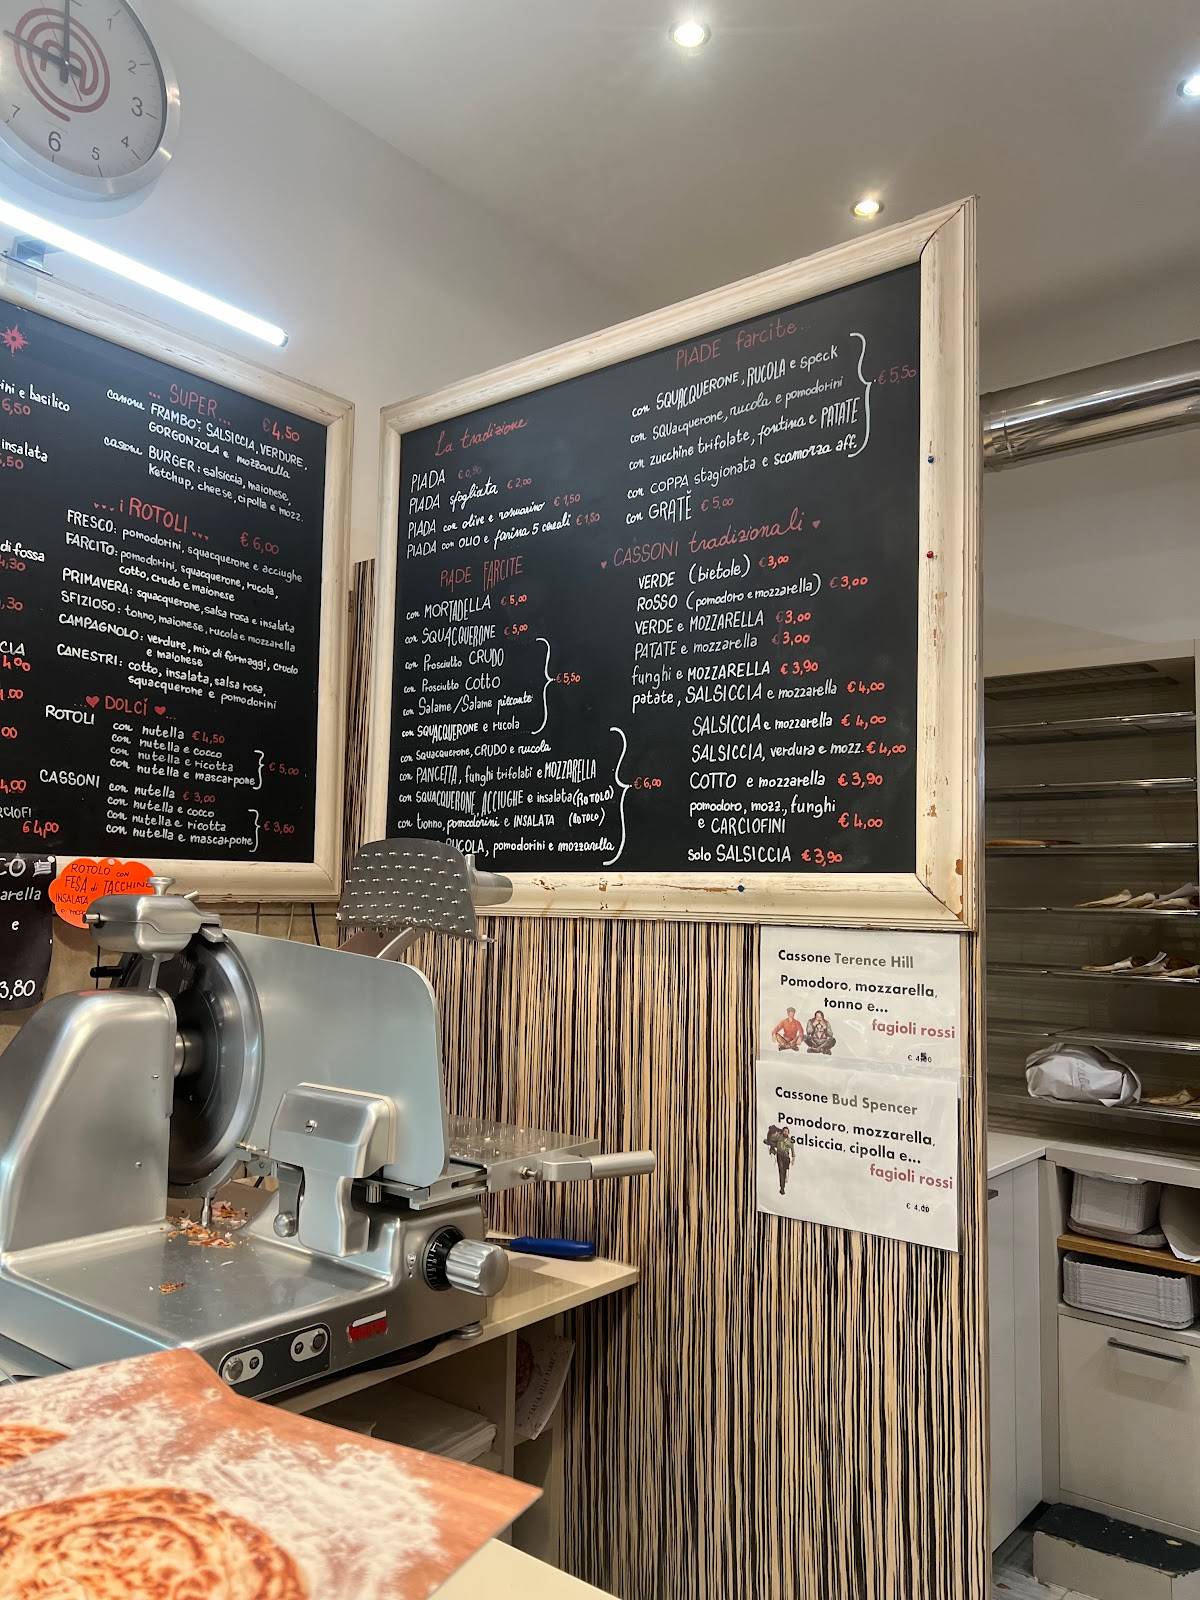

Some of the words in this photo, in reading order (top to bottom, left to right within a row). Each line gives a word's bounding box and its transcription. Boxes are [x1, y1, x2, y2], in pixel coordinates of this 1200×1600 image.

[128, 60, 137, 74] 2
[131, 97, 143, 116] 3
[49, 131, 62, 152] 6
[92, 147, 100, 161] 5
[676, 340, 721, 371] PIADE
[747, 359, 786, 387] RUCOLA
[800, 345, 838, 372] speck
[29, 384, 70, 411] basilico
[170, 384, 217, 418] SUPER
[730, 393, 771, 416] rucola
[785, 376, 843, 407] pomodorini
[149, 422, 219, 454] GORGONZOLA
[461, 418, 528, 449] tradizione
[650, 445, 694, 467] zucchine
[698, 429, 755, 454] trifolate,
[758, 417, 806, 445] fontina
[820, 397, 860, 429] PATATE
[1, 438, 48, 462] insalata
[203, 467, 245, 489] salsiccia,
[248, 481, 291, 506] maionese,
[411, 469, 445, 493] PIADA
[650, 474, 689, 495] COPPA
[694, 457, 756, 487] stagionata
[409, 494, 440, 514] PIADA
[450, 476, 498, 512] sfogliata
[129, 497, 188, 533] ROTOLI
[408, 519, 436, 539] PIADA
[462, 515, 484, 530] olive
[67, 509, 117, 534] FRESCO:
[122, 529, 185, 553] pomodorini,
[188, 546, 250, 569] squacquerone
[262, 565, 302, 583] acciughe
[407, 540, 437, 559] PIADA
[459, 536, 480, 549] OLIO
[494, 527, 530, 550] farina
[613, 541, 678, 567] CASSONI
[688, 506, 804, 555] tradizionali
[13, 542, 45, 562] fossa
[66, 532, 117, 557] FARCITO:
[120, 550, 177, 572] pomodorini,
[181, 565, 245, 590] squacquerone,
[247, 582, 279, 599] rucola,
[484, 556, 523, 590] FARCITE
[638, 572, 676, 590] VERDE
[688, 554, 750, 585] (bietole)
[119, 566, 149, 582] cotto,
[151, 573, 180, 588] crudo
[192, 583, 235, 601] maionese
[637, 597, 678, 612] ROSSO
[686, 591, 744, 612] (pomodoro
[754, 573, 821, 598] mozzarella)
[840, 575, 868, 589] 3,00
[62, 567, 133, 595] PRIMAVERA:
[205, 606, 227, 618] salsa
[230, 612, 249, 623] rosa
[260, 617, 295, 633] insalata
[406, 610, 420, 620] con
[424, 595, 491, 622] MORTADELLA
[125, 606, 157, 624] tonno,
[248, 635, 295, 652] mozzarella
[422, 625, 496, 647] SQUACQUERONE
[635, 619, 673, 636] VERDE
[689, 610, 764, 633] MOZZARELLA
[784, 610, 812, 625] 3,00
[58, 613, 144, 641] CAMPAGNOLO:
[147, 633, 191, 653] verdure,
[193, 644, 211, 656] mix
[273, 663, 299, 675] crudo
[634, 641, 677, 661] PATATE
[693, 633, 757, 654] mozzarella
[782, 631, 810, 645] 3,00
[57, 644, 122, 666] CANESTRI:
[128, 661, 162, 677] cotto,
[166, 668, 212, 687] insalata,
[214, 675, 240, 689] salsa
[156, 650, 203, 667] maionese
[424, 654, 462, 671] Prosciutto
[469, 648, 504, 667] CRUDO
[421, 678, 459, 692] Prosciutto
[632, 665, 672, 690] funghi
[687, 660, 770, 682] MOZZARELLA
[792, 659, 818, 677] 3,90
[128, 675, 203, 697] squacquerone
[221, 693, 276, 710] pomodorini
[685, 682, 762, 705] SALSICCIA
[778, 678, 837, 700] mozzarella
[858, 681, 885, 696] 4,00
[45, 705, 95, 725] ROTOLI
[692, 713, 761, 737] SALSICCIA
[774, 711, 832, 731] mozzarella
[855, 714, 887, 730] 4,00
[113, 722, 133, 732] con
[142, 725, 185, 740] nutella
[417, 722, 478, 743] SQUACQUERONE
[493, 716, 519, 731] rucola
[193, 748, 223, 759] cocco
[475, 744, 507, 756] CRUDO
[518, 740, 551, 754] rucola
[691, 743, 766, 763] SALSICCIA,
[770, 742, 815, 758] verdura
[830, 742, 864, 755] mozz.
[39, 769, 100, 788] CASSONI
[195, 759, 234, 773] ricotta
[195, 770, 256, 788] mascarpone
[416, 765, 462, 785] PANCETTA,
[465, 766, 493, 786] funghi
[496, 768, 533, 780] trifolati
[545, 758, 596, 783] MOZZARELLA
[134, 784, 175, 799] nutella
[689, 772, 737, 789] COTTO
[758, 770, 825, 788] mozzarella
[851, 772, 883, 788] 3,90
[481, 789, 523, 816] ACCIUGHE
[537, 792, 572, 803] insalata
[689, 798, 747, 817] pomodoro,
[790, 794, 836, 818] funghi
[188, 820, 226, 832] ricotta
[447, 816, 500, 835] pomodorini
[514, 814, 555, 827] INSALATA
[710, 817, 786, 837] CARCIOFINI
[854, 814, 883, 830] 4,00
[190, 833, 254, 848] mascarpone
[493, 837, 545, 857] pomodorini
[716, 844, 792, 863] SALSICCIA
[814, 849, 843, 867] 3,90
[71, 864, 110, 876] ROTOLO
[65, 876, 88, 893] FESA
[56, 894, 88, 904] INSALATA
[778, 950, 831, 963] Cassone
[834, 952, 886, 967] Terence
[891, 955, 913, 968] Hill
[780, 975, 851, 992] Pomodoro,
[855, 982, 938, 998] mozzarella,
[824, 997, 863, 1011] tonno
[867, 1002, 888, 1013] e...
[871, 1018, 916, 1036] fagioli
[920, 1025, 956, 1039] rossi
[775, 1086, 828, 1103] Cassone
[832, 1093, 858, 1108] Bud
[862, 1097, 918, 1115] Spencer
[778, 1112, 849, 1134] Pomodoro,
[853, 1125, 936, 1147] mozzarella,
[790, 1134, 846, 1152] salsiccia,
[849, 1143, 895, 1160] cipolla
[899, 1151, 921, 1164] e...
[869, 1163, 915, 1183] fagioli
[919, 1174, 953, 1190] rossi
